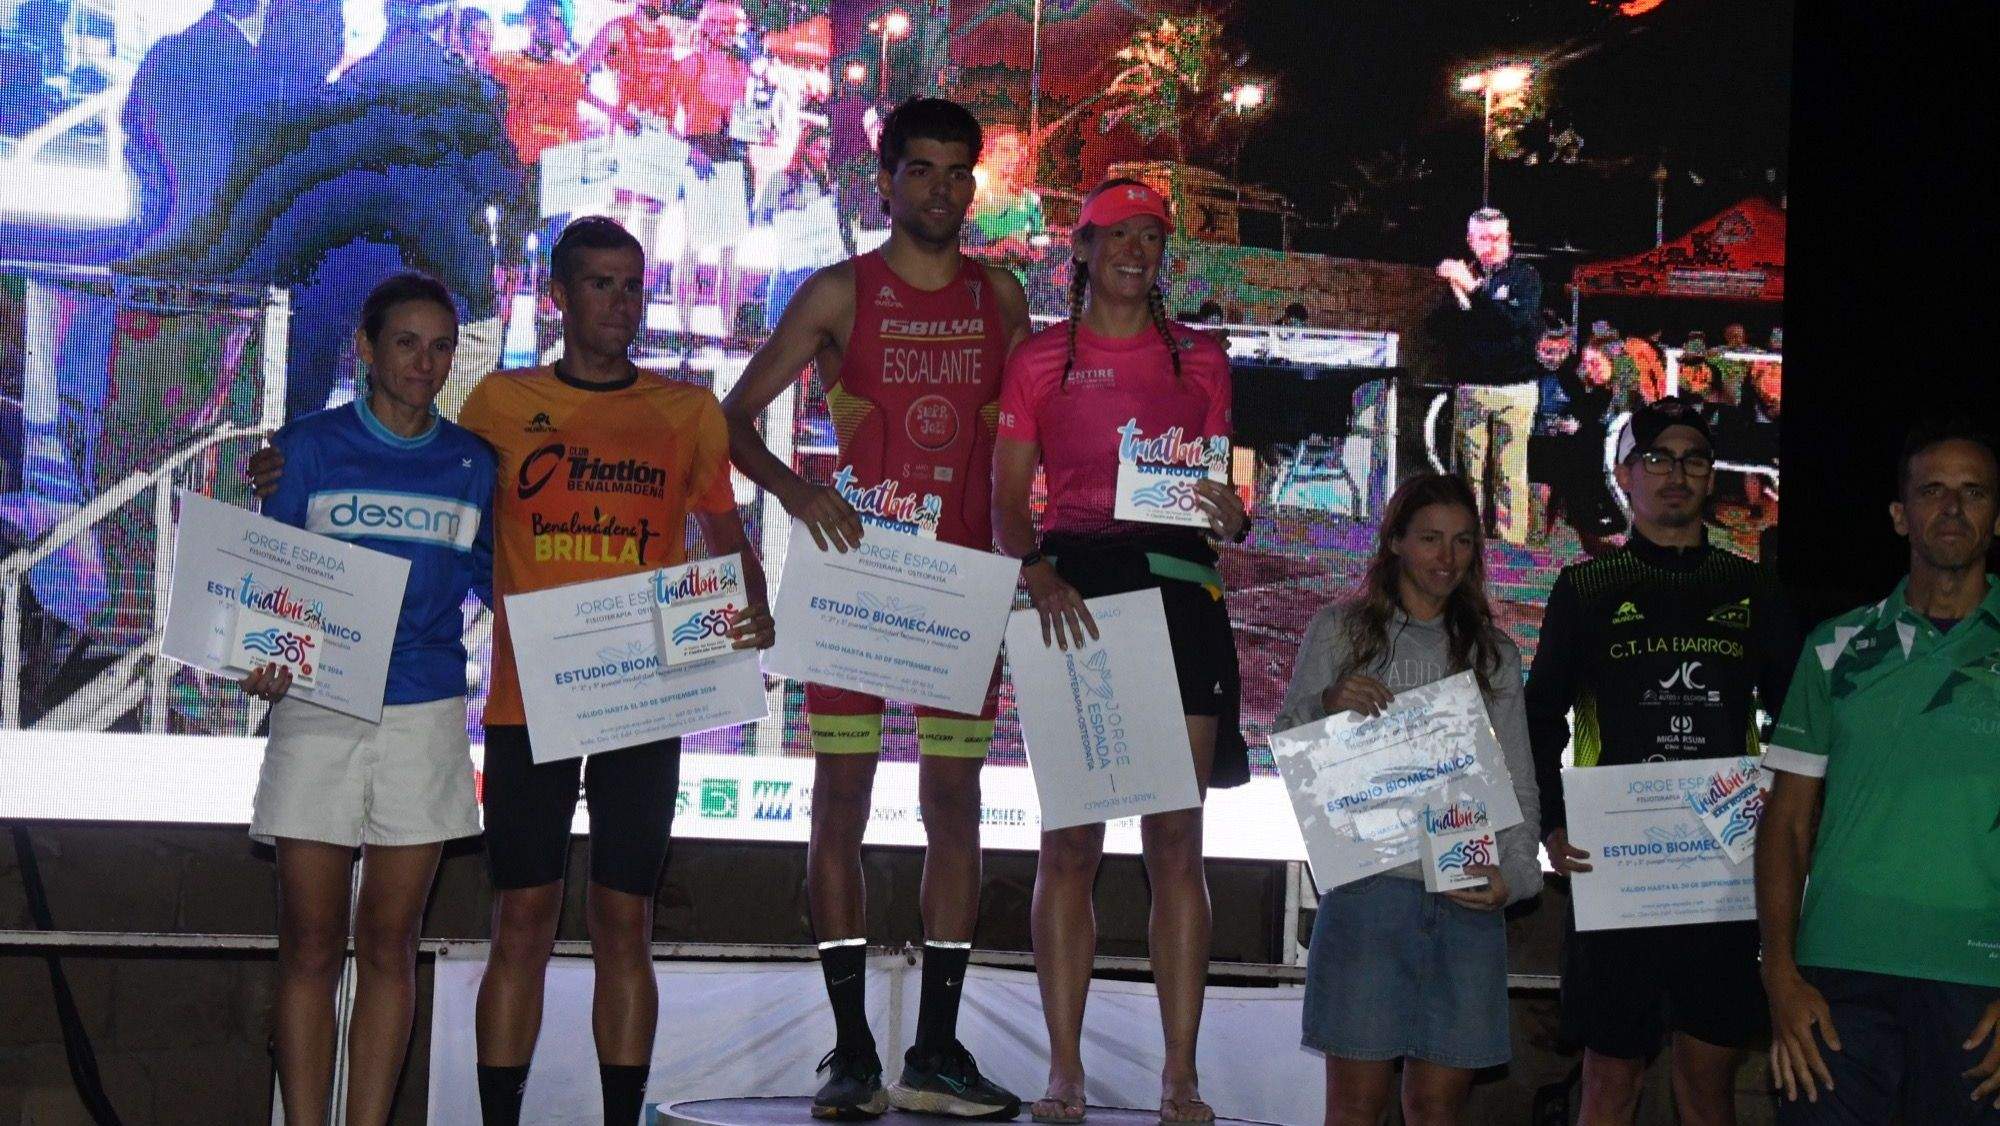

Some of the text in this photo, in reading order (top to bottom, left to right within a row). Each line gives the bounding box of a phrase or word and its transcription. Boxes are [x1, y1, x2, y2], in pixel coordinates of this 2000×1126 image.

[880, 318, 984, 337] ISBILYA
[882, 347, 982, 385] ESCALANTE
[1067, 368, 1115, 381] ENTIRE
[569, 446, 590, 457] CLUB
[567, 456, 668, 488] Triatlón
[1137, 464, 1209, 480] SAN ROQUE
[330, 494, 461, 539] desam
[875, 519, 919, 536] ROQUE
[241, 529, 346, 573] JORGE ESPADA
[535, 532, 640, 563] BRILLA
[855, 543, 959, 575] ORGE ESPADA
[574, 595, 624, 616] JORGE
[810, 596, 972, 642] ESTUDIO BIOMECÁNICO
[1647, 637, 1668, 653] LA
[554, 662, 617, 685] ESTUDIO
[576, 707, 602, 719] VÁLIDO
[630, 701, 637, 709] EL
[649, 696, 657, 705] DE
[659, 689, 698, 702] SEPTIEMBRE
[1087, 703, 1110, 769] ESPADA
[1105, 699, 1129, 766] JORGE
[1326, 784, 1383, 813] ESTUDIO
[1384, 752, 1475, 793] BIOMECÁNICO
[1627, 779, 1673, 793] JORGE
[1603, 843, 1662, 857] ESTUDIO
